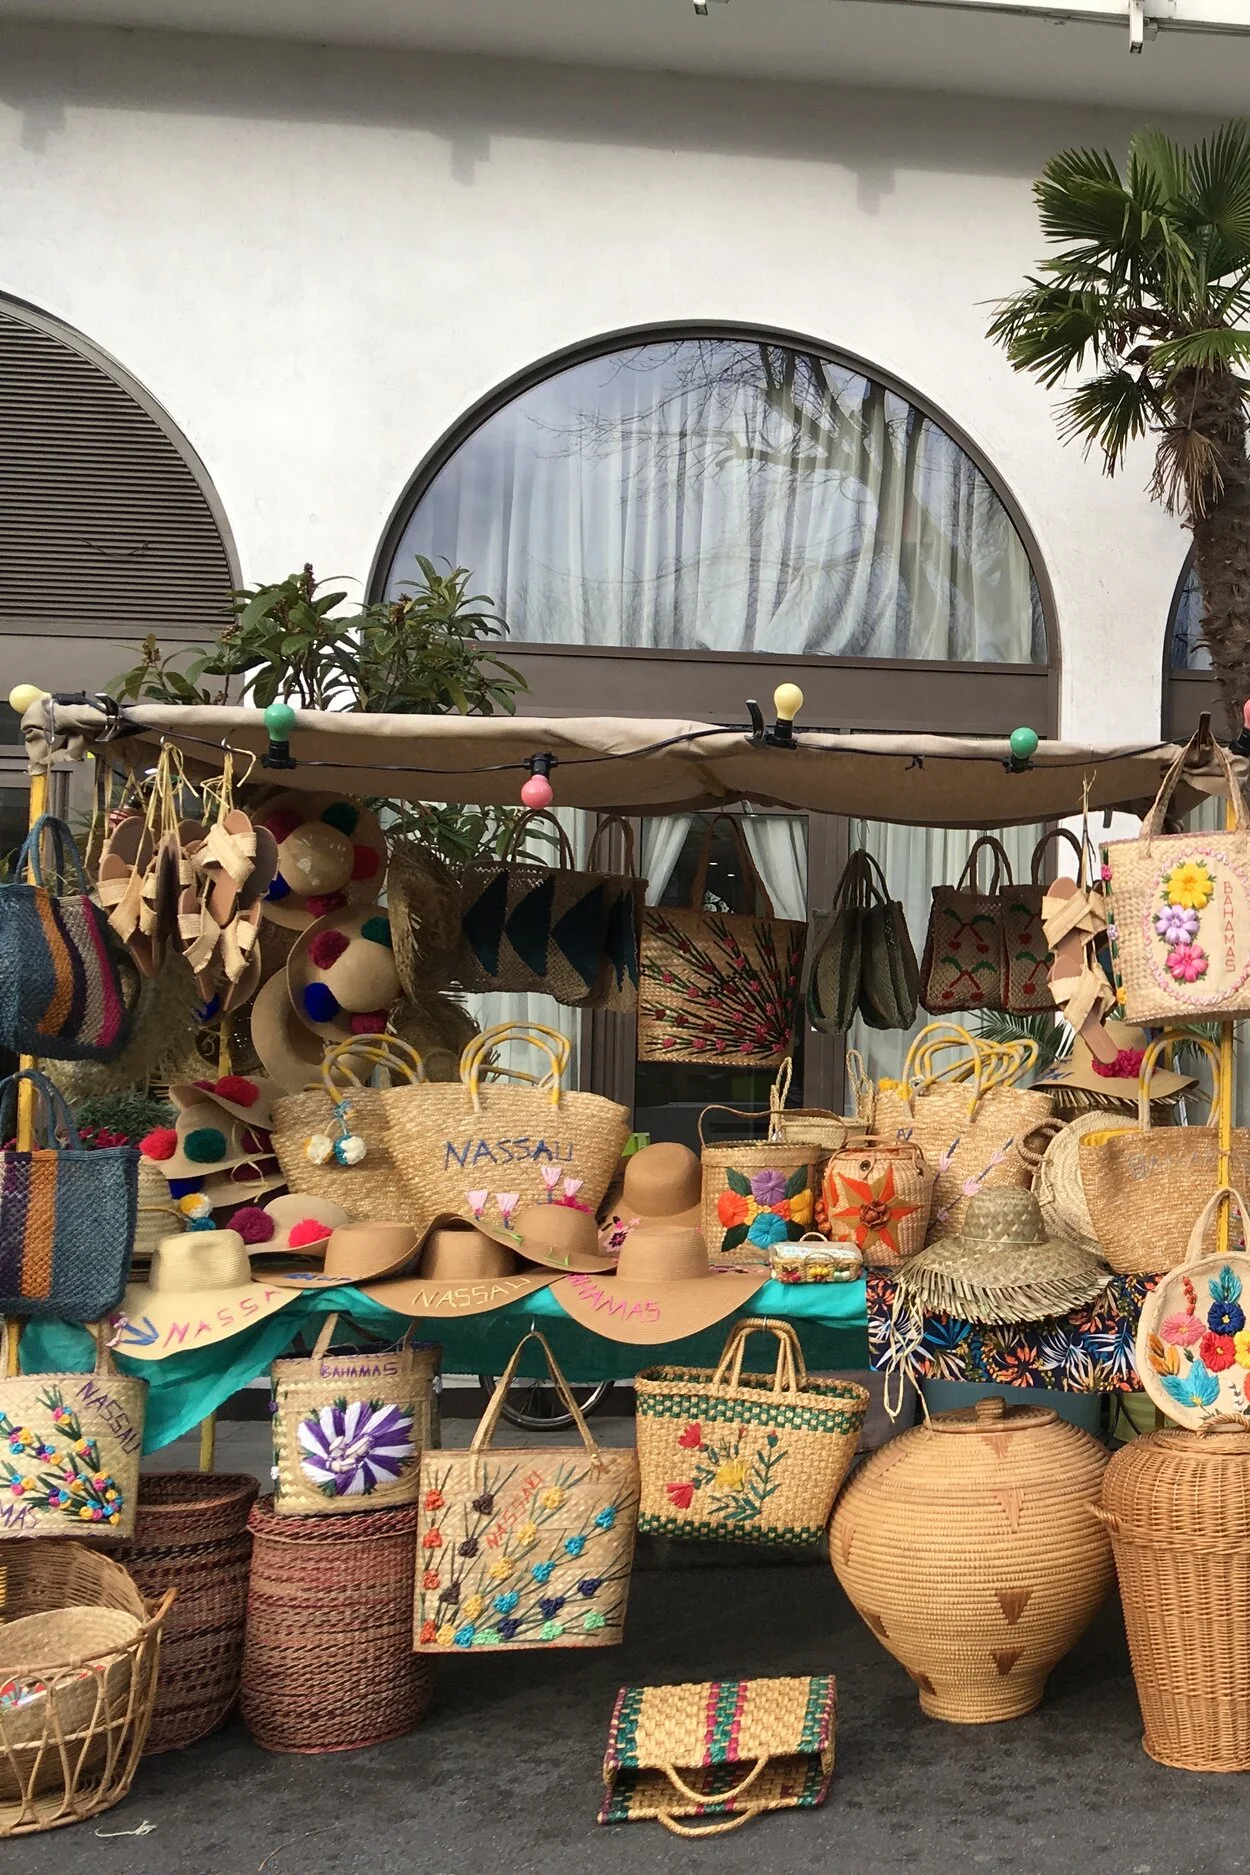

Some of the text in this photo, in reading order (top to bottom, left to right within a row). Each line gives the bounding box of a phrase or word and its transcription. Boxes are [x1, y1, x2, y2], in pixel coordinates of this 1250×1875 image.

[1223, 881, 1236, 973] BAHAMAS
[443, 1137, 573, 1171] NASSAU
[411, 1277, 532, 1308] NASSAU
[320, 1361, 398, 1379] BAHAMAS
[75, 1380, 142, 1455] NASSAU
[486, 1471, 544, 1550] NASSAU
